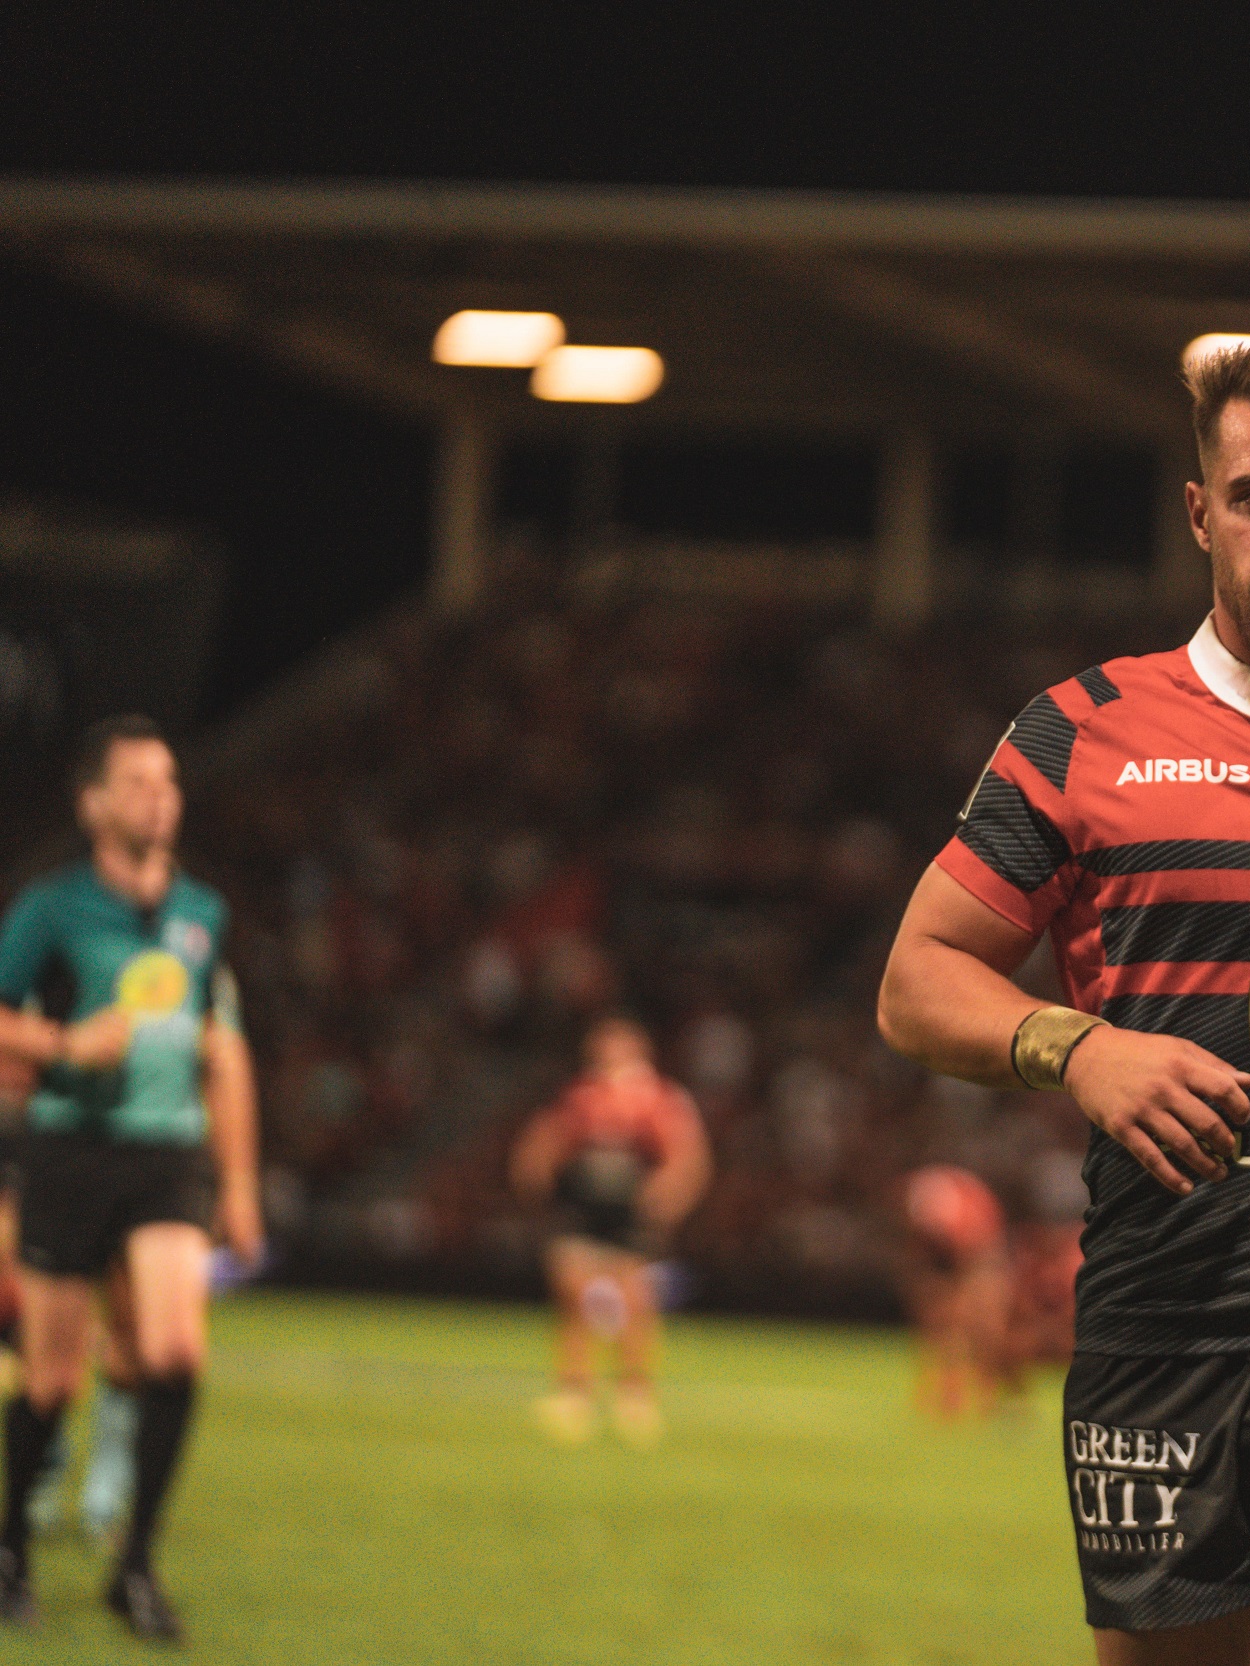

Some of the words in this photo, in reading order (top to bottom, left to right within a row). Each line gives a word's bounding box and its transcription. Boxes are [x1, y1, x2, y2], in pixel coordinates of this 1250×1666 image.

[1116, 758, 1250, 786] AIRBUS
[1070, 1420, 1200, 1470] GREEN
[1073, 1467, 1190, 1528] CITY
